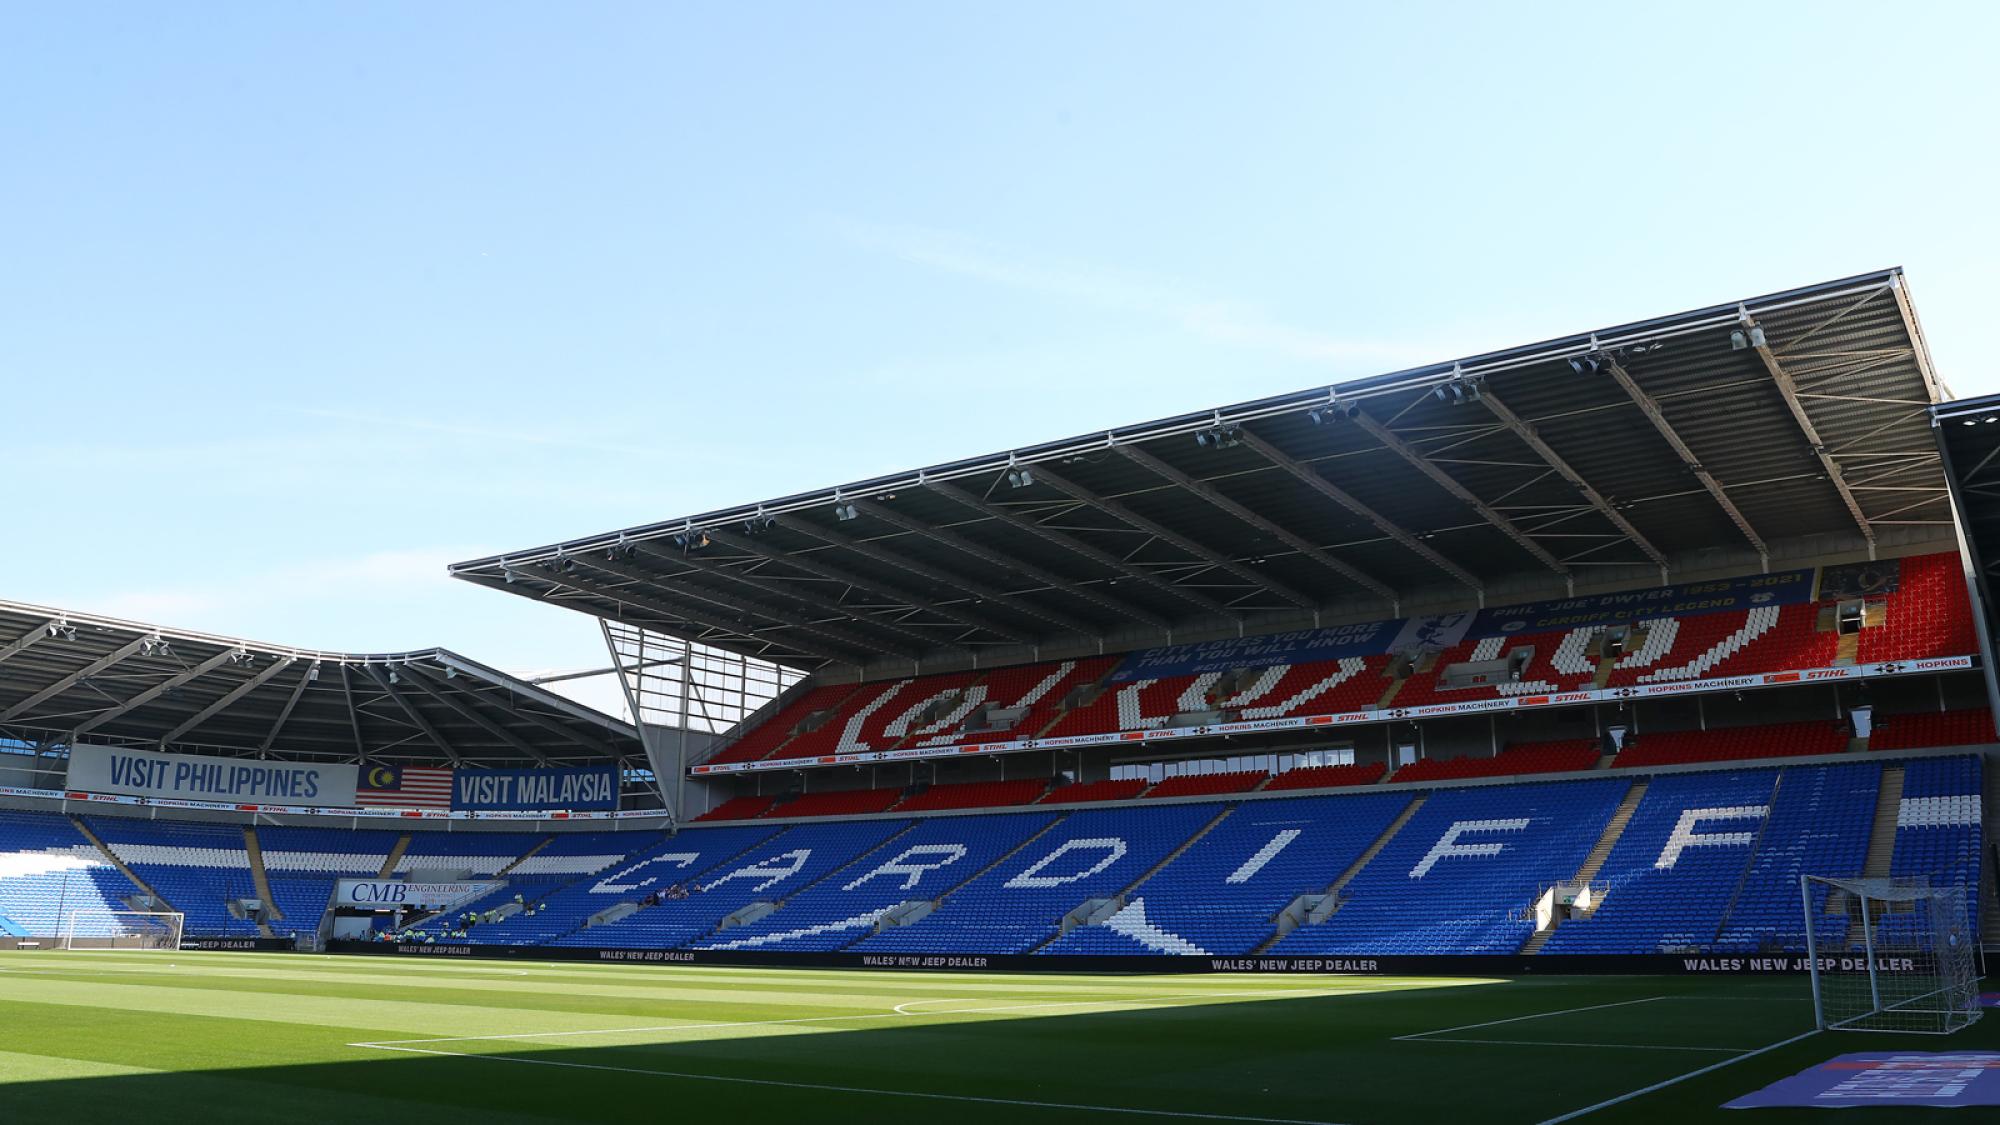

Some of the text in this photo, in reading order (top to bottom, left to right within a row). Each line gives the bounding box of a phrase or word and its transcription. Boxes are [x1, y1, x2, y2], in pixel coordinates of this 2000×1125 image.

[1493, 605, 1535, 617] PHIL
[1600, 589, 1674, 605] DWYER
[1536, 597, 1735, 627] CARDIFF CITY LEGEND
[1144, 622, 1384, 657] CITY LOVES YOU MORE
[1137, 632, 1377, 668] THAN YOU WILL KNOW
[1916, 658, 1969, 670] HOPKINS
[1806, 668, 1849, 680] STIHL
[1648, 678, 1755, 693] HOPKINS MACHINERY
[1556, 692, 1591, 702] STIHL
[1418, 700, 1509, 714] HOPKINS MACHINERY
[1337, 713, 1369, 722] STIHL
[1219, 719, 1299, 732] HOPKINS MACHINERY
[1148, 730, 1176, 738] STIHL
[1044, 735, 1115, 746] HOPKINS MACHINERY
[110, 755, 320, 798] VISIT PHILIPPINES
[460, 773, 612, 804] VISIT MALAYSIA
[351, 883, 407, 902] CMB
[408, 884, 470, 893] ENGINEERING
[221, 940, 256, 949] DEALER
[419, 945, 432, 953] NEW
[448, 946, 471, 955] DEALER
[600, 950, 695, 961] WALES' NEW JEEP DEALER
[863, 956, 987, 967] WALES' NEW JEEP DEALER
[1212, 959, 1378, 971] WALES' NEW JEEP DEALER
[1684, 959, 1746, 971] WALES'
[1750, 959, 1788, 971] NEW
